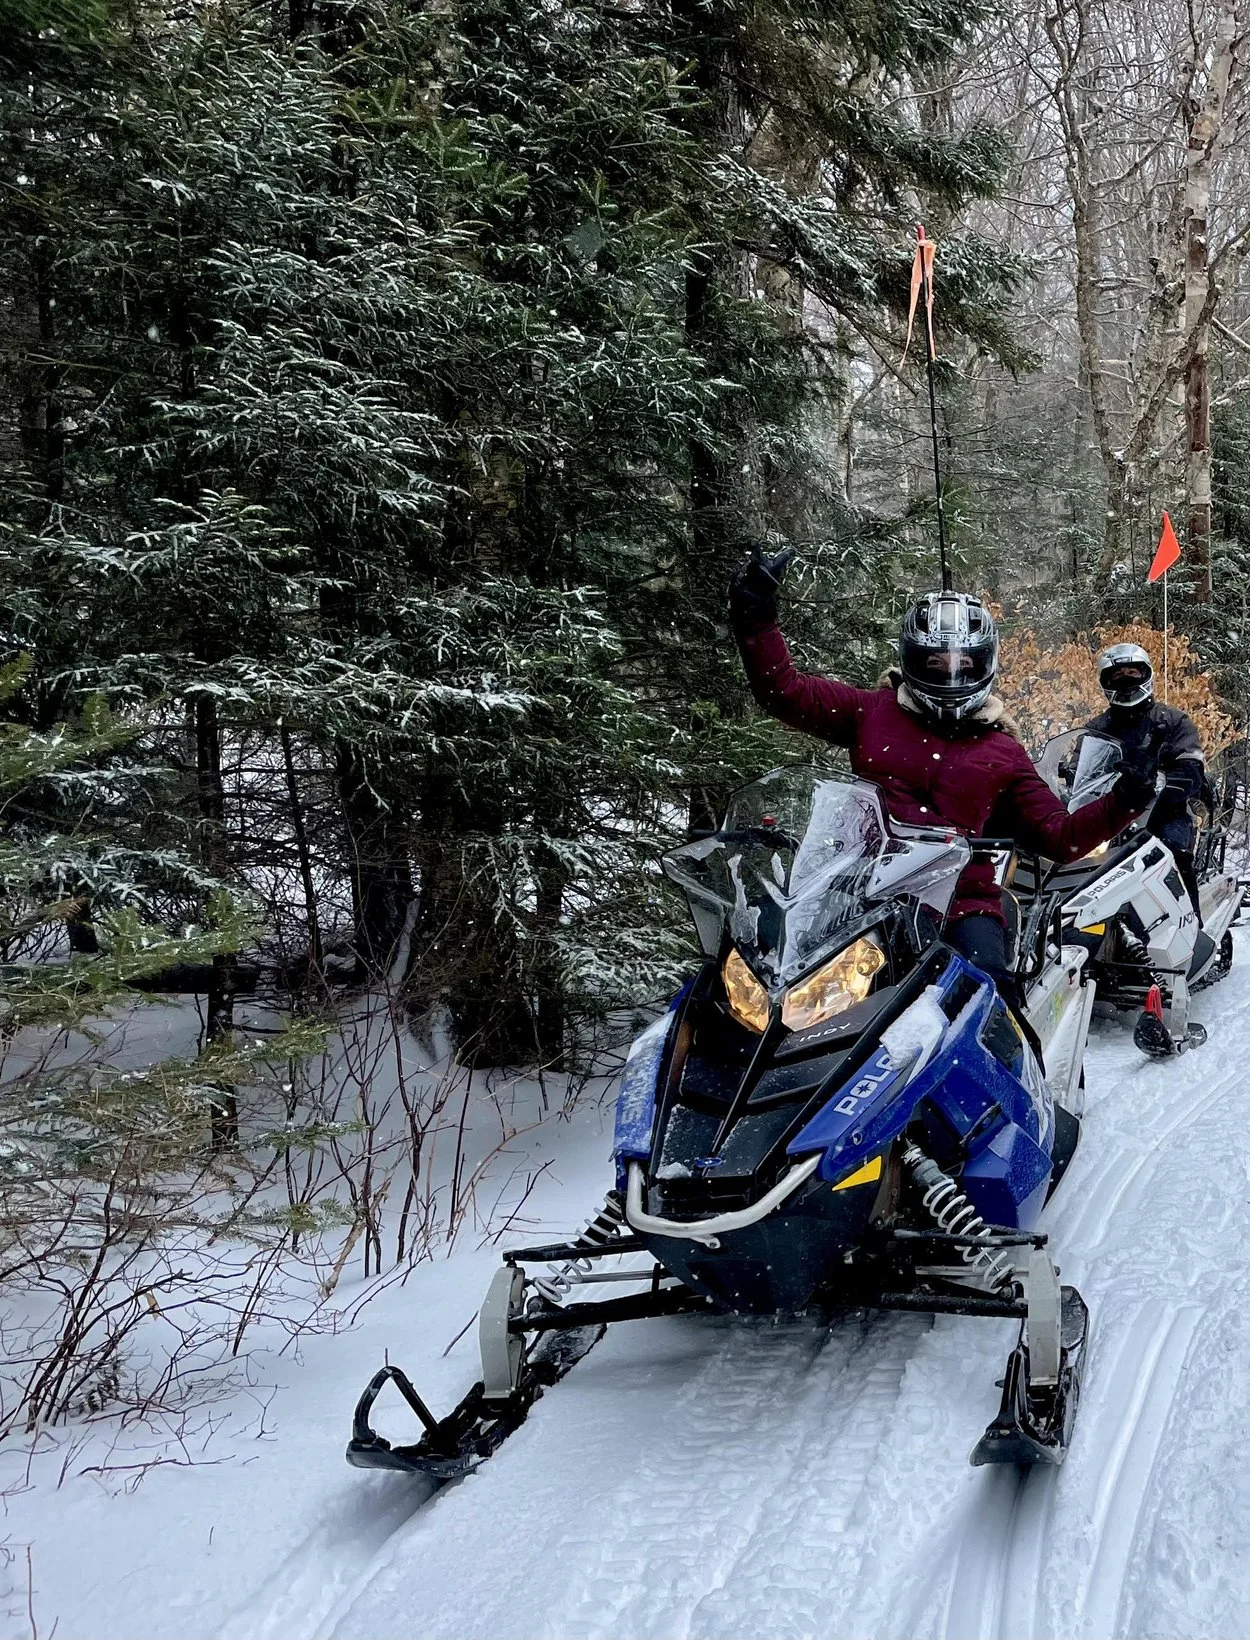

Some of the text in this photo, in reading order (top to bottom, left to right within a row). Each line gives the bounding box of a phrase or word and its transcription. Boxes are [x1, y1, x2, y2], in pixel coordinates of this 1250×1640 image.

[1088, 870, 1127, 896] POLARIS
[800, 1023, 851, 1042] INDY
[833, 1054, 895, 1116] POLA
